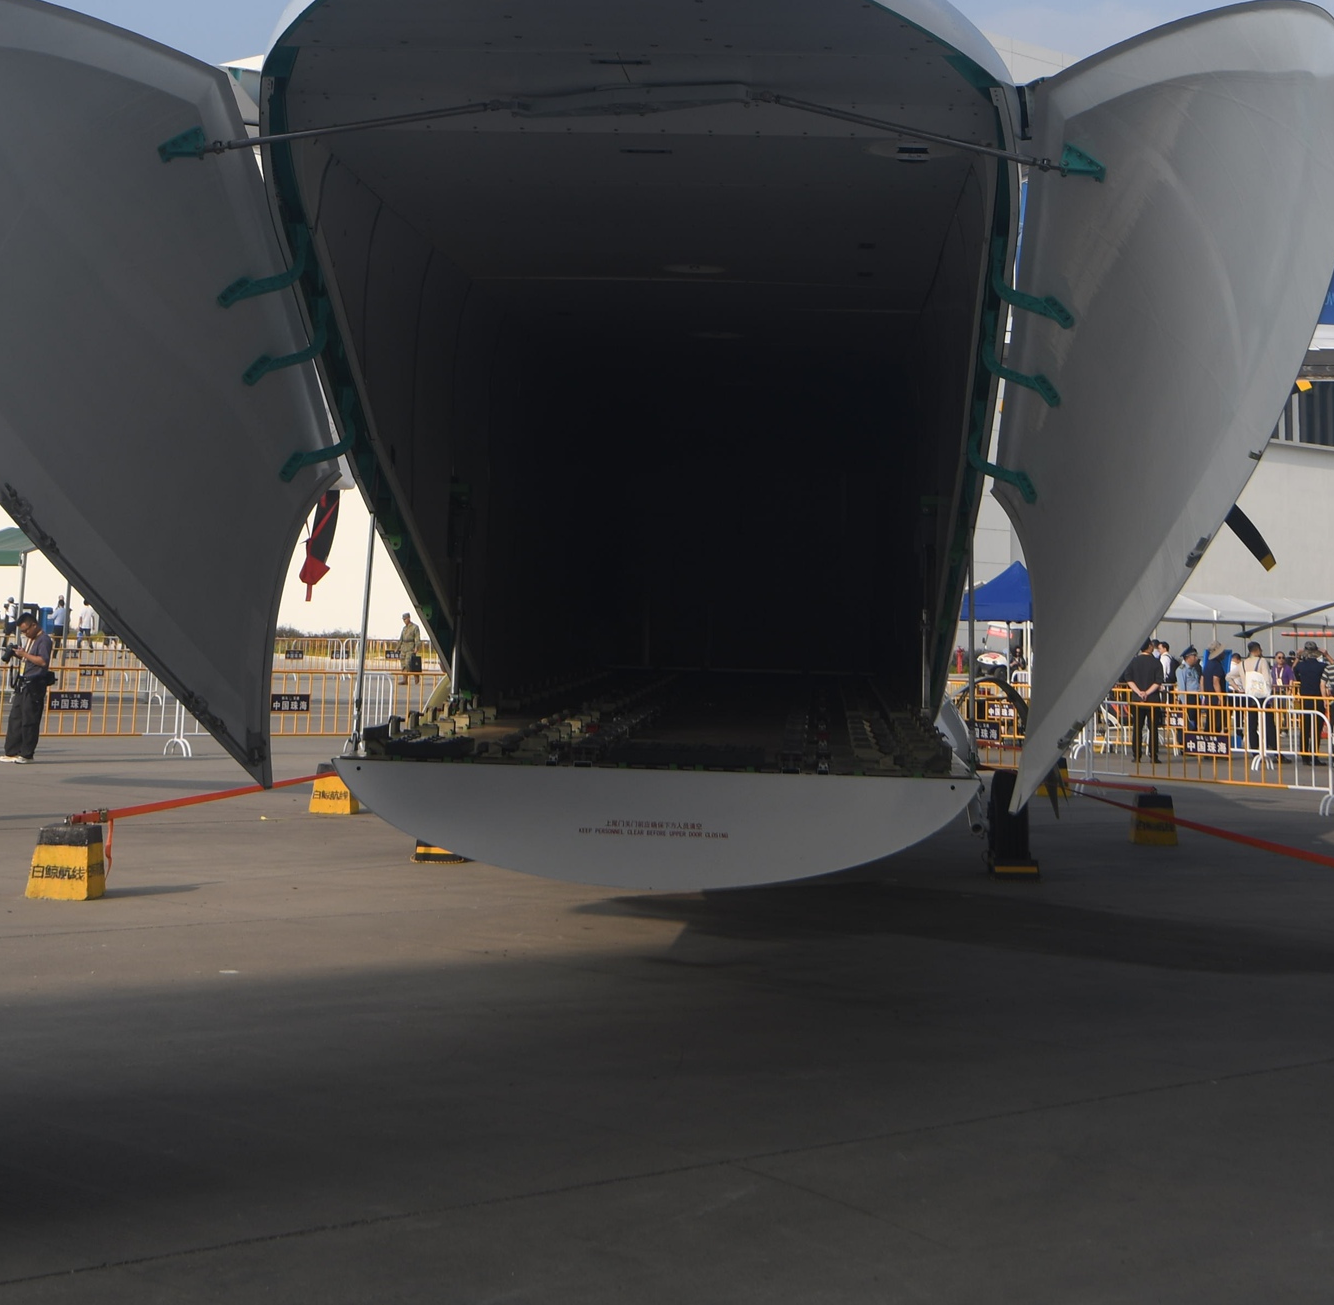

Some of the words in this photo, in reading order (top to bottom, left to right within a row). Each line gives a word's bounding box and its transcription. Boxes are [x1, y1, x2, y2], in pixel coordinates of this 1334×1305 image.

[51, 699, 89, 710] 中国珠海
[273, 701, 307, 710] 中国珠海
[1186, 740, 1227, 754] 中国珠海
[31, 864, 86, 881] 白鲸航线
